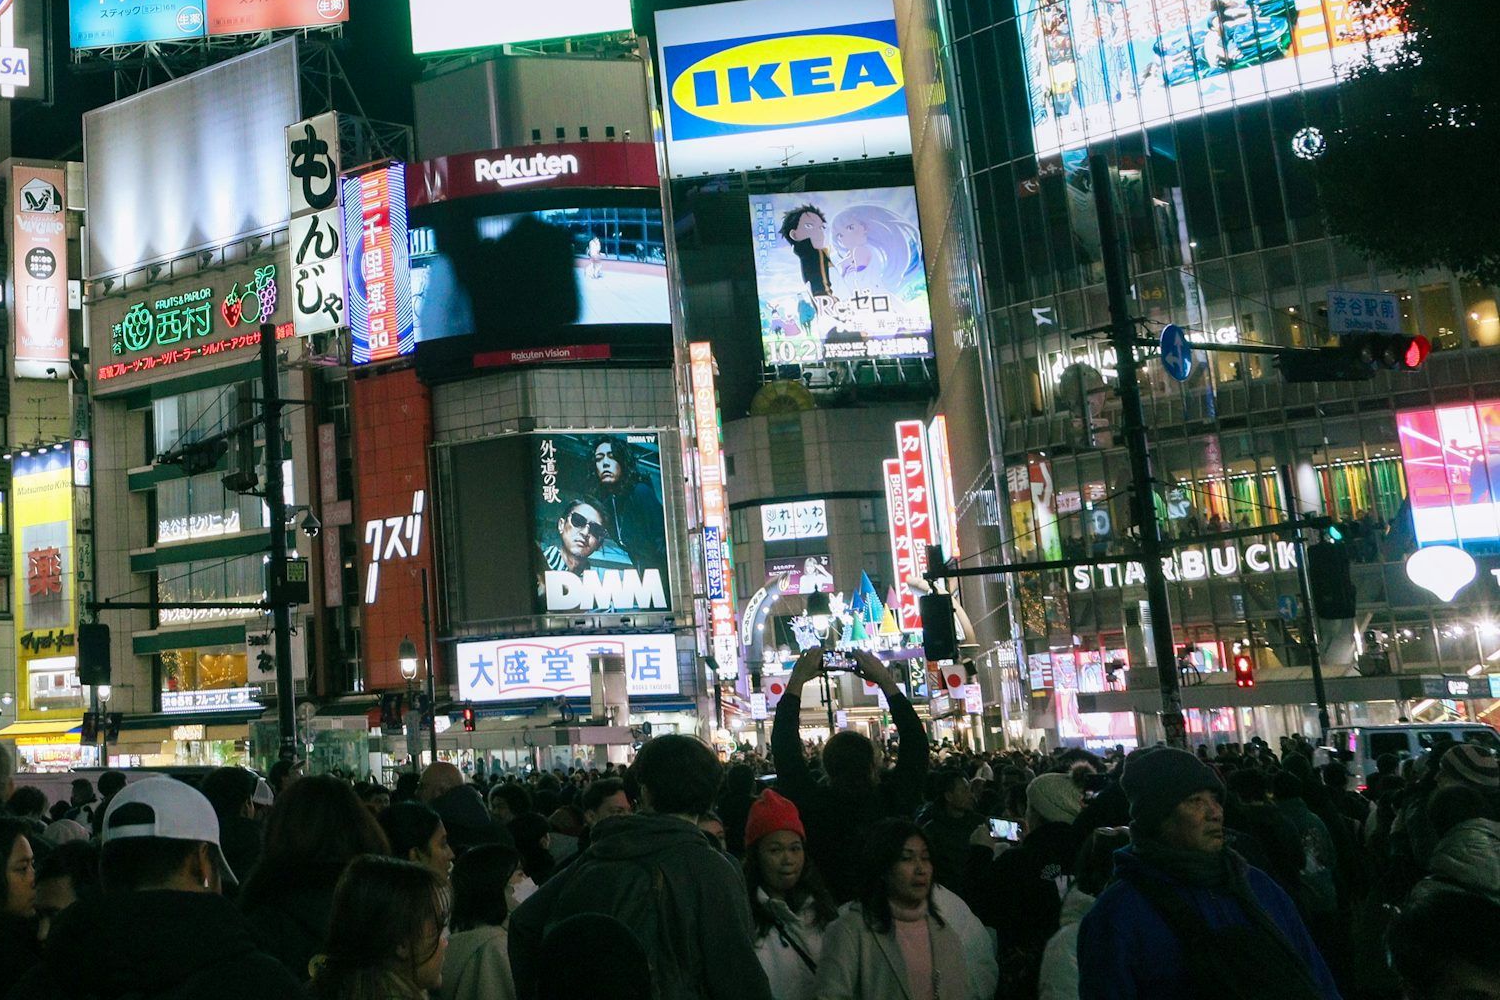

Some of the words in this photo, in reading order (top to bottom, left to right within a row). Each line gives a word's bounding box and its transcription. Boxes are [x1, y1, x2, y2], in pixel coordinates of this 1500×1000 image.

[693, 50, 898, 108] IKEA
[475, 153, 578, 184] Rakuten
[290, 124, 344, 324] もんじゃ
[156, 302, 212, 345] 西村
[511, 350, 544, 362] Rakuten
[545, 348, 570, 359] Vision
[540, 440, 562, 504] 外道の歌
[903, 434, 928, 528] カラオケ
[767, 522, 824, 537] クリニック
[779, 506, 823, 519] れいわ
[28, 545, 62, 596] 薬
[545, 569, 667, 610] DMM
[469, 646, 662, 688] 大盛堂店
